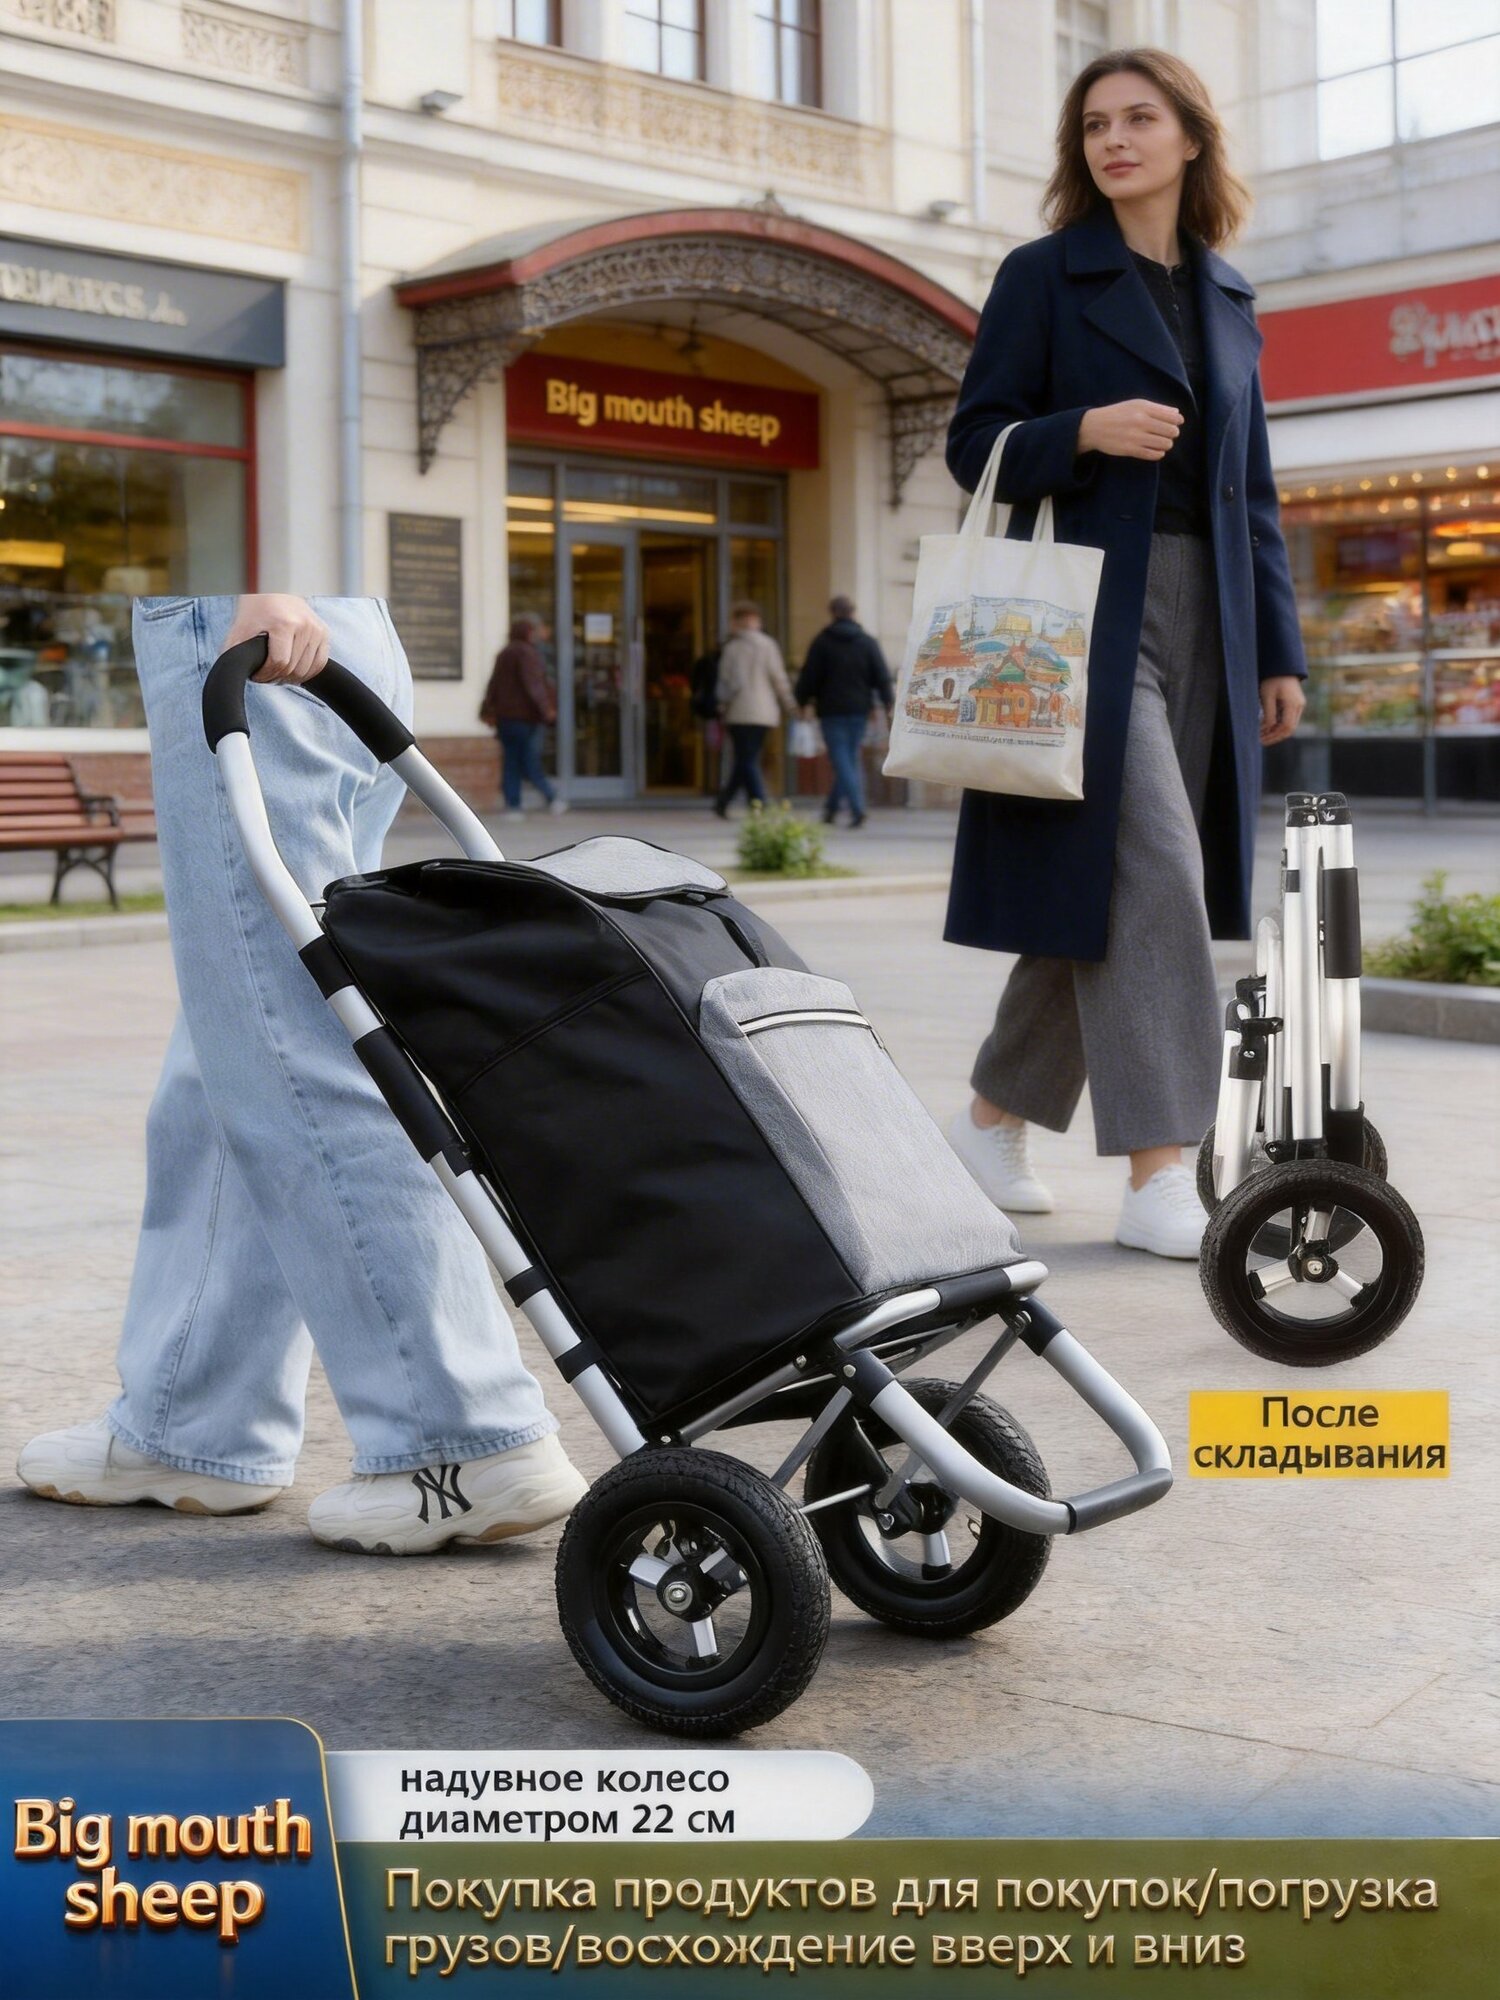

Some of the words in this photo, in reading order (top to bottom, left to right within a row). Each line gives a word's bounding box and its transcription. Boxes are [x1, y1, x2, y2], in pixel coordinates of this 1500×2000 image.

[546, 379, 597, 426] Big
[604, 394, 694, 429] mouth
[700, 400, 781, 446] sheep
